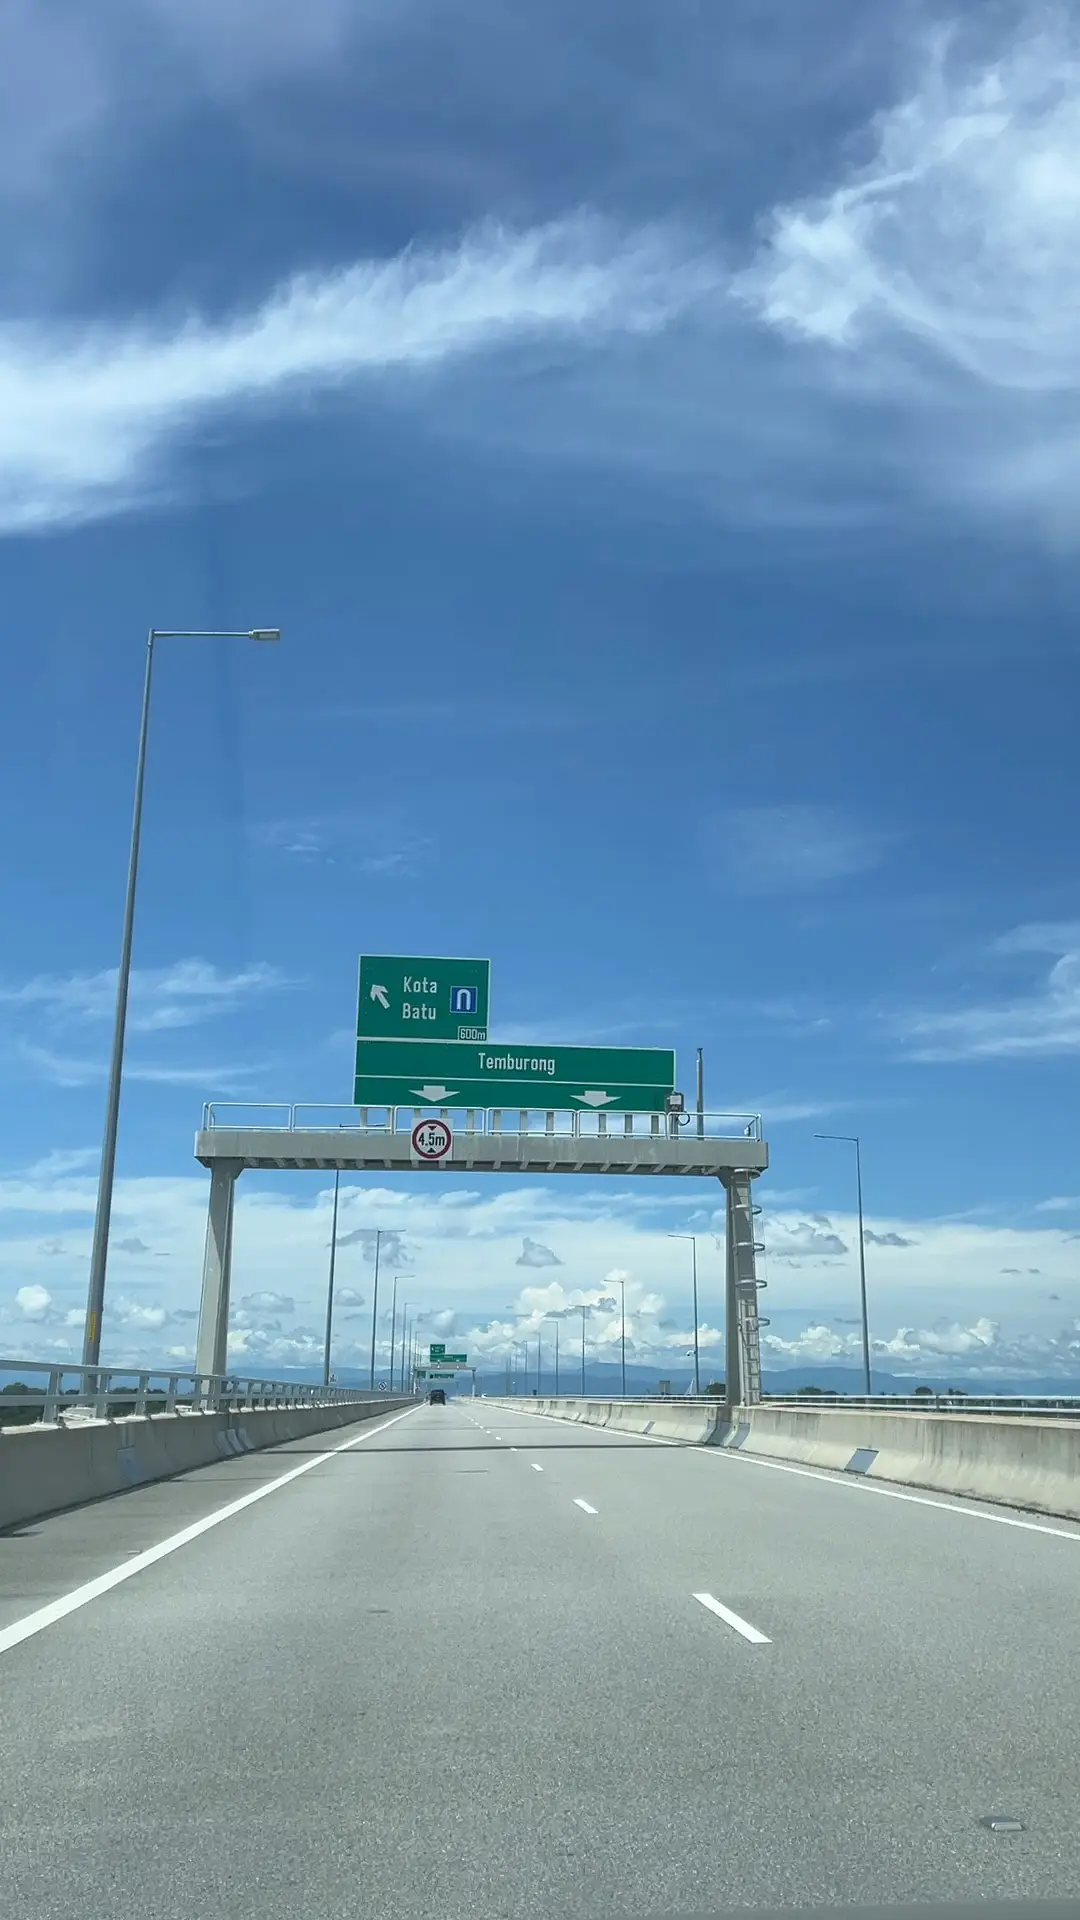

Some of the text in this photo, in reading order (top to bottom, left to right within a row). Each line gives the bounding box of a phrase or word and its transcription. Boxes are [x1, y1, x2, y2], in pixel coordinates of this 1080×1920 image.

[403, 976, 437, 993] Kota
[402, 1003, 436, 1020] Batu
[460, 1028, 486, 1040] 600m
[478, 1053, 555, 1075] Temburong
[418, 1131, 445, 1147] 4.5m
